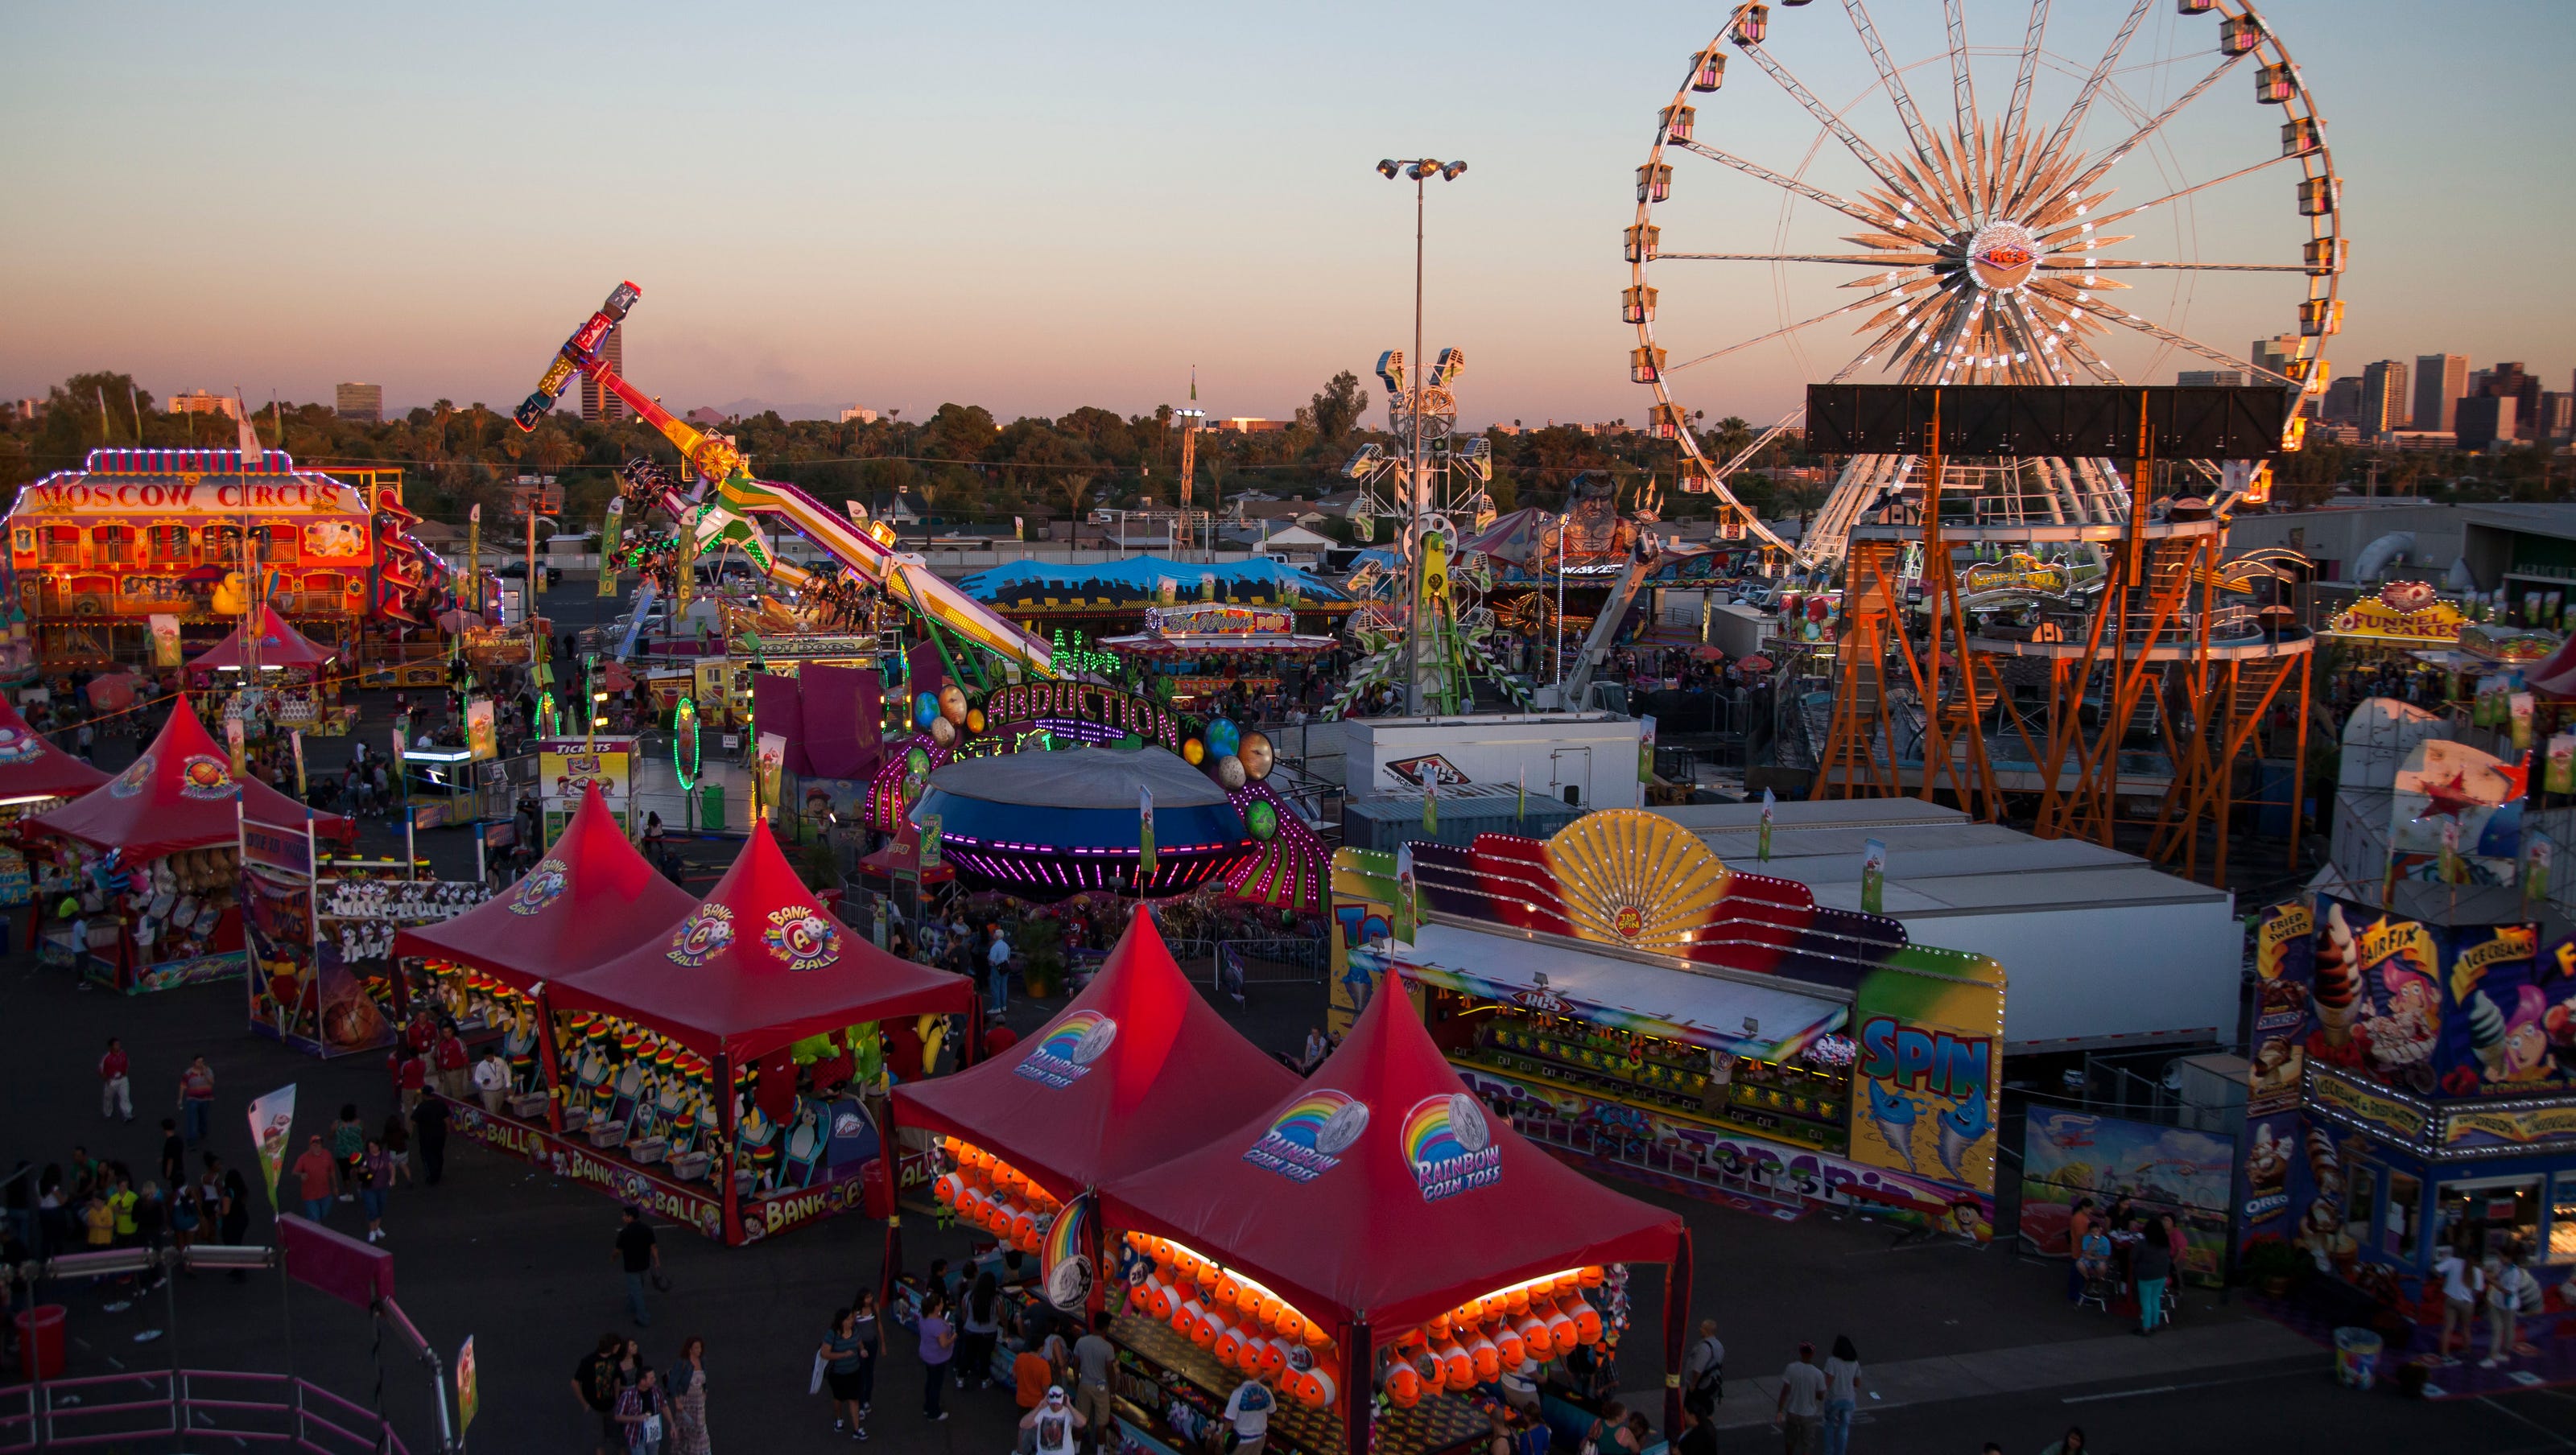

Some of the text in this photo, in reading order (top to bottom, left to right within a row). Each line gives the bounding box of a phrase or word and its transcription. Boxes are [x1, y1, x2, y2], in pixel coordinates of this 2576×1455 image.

[1990, 249, 2028, 262] RCS
[34, 484, 340, 508] MOSCOW CIRCUS
[470, 525, 478, 607] TANGO
[1167, 612, 1286, 633] Balloon POP
[2352, 611, 2444, 629] FUNNEL
[2384, 622, 2460, 638] CAKES
[760, 643, 856, 653] HOT DOGS
[988, 682, 1180, 755] ABDUCTION
[543, 859, 568, 873] BANK
[530, 880, 547, 896] A
[508, 901, 539, 915] BALL
[702, 903, 734, 921] BANK
[767, 905, 814, 926] BANK
[1619, 913, 1637, 923] TOP
[1618, 920, 1640, 929] SPIN
[2269, 913, 2303, 932] FRIED
[2269, 922, 2308, 942] SWEETS
[690, 926, 710, 944] A
[793, 929, 811, 950] A
[2360, 925, 2419, 965] FAIR FIX
[666, 950, 703, 967] BALL
[789, 954, 840, 971] BALL
[2464, 940, 2535, 969] ICE CREAMS
[1525, 992, 1561, 1012] RCS
[1021, 1048, 1092, 1079] RAINBOW
[1858, 1017, 1993, 1100] SPIN
[1013, 1064, 1047, 1081] COIN
[487, 1123, 529, 1155] BALL
[1252, 1130, 1341, 1173] RAINBOW
[572, 1150, 616, 1187] BANK
[1243, 1149, 1320, 1184] COIN TOSS
[1418, 1144, 1501, 1189] RAINBOW
[627, 1177, 638, 1197] A
[846, 1181, 860, 1206] A
[1422, 1165, 1501, 1203] COIN TOSS
[655, 1190, 702, 1227] BALL
[766, 1192, 828, 1234] BANK
[2245, 1194, 2289, 1214] OREO
